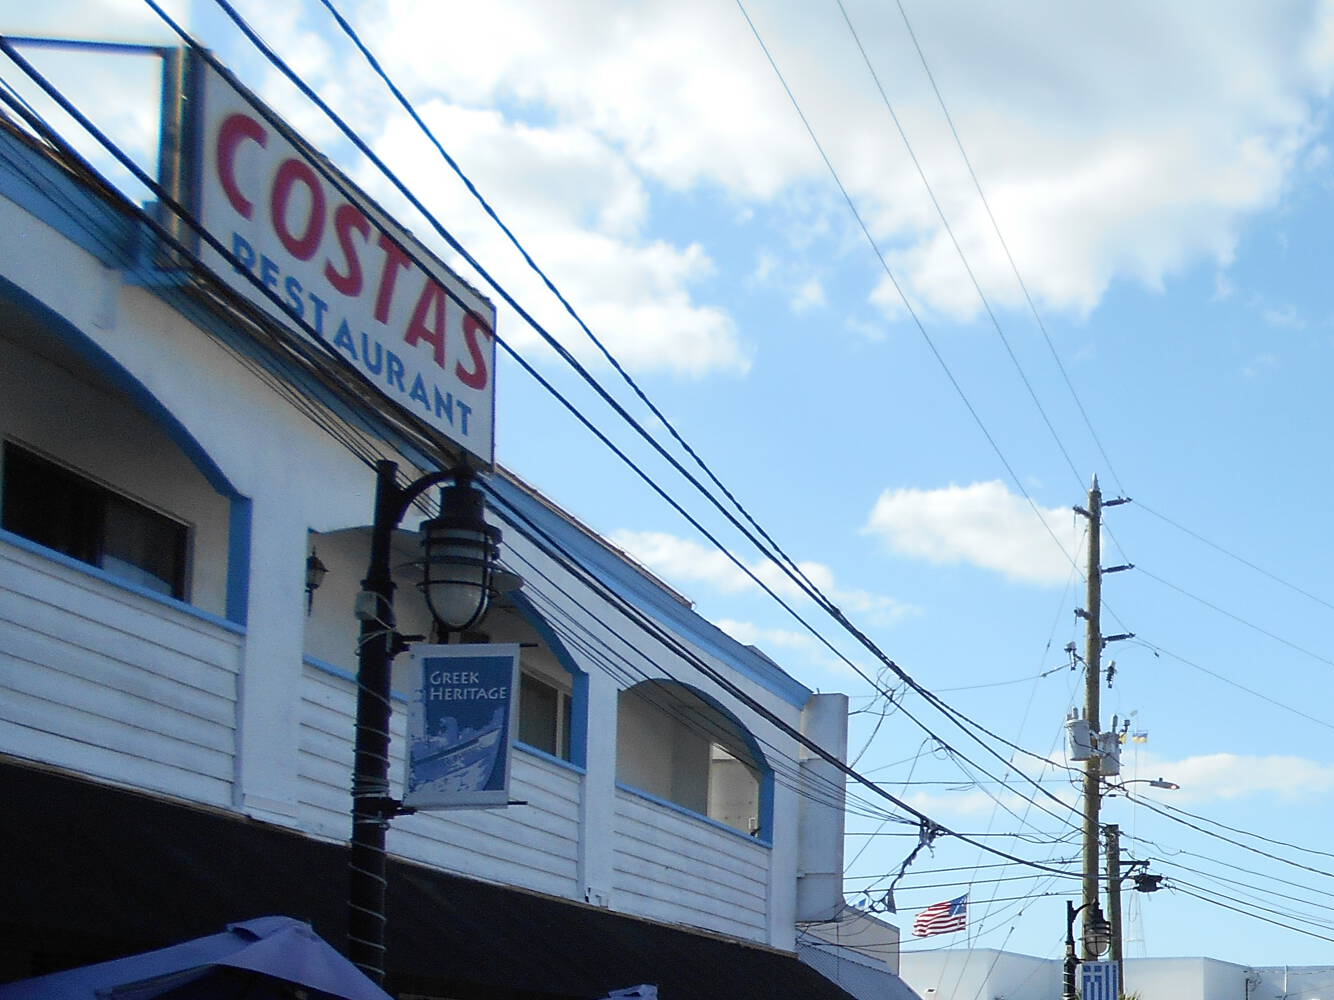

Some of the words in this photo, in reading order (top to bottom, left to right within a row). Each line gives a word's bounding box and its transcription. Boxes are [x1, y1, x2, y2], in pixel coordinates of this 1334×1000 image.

[216, 113, 493, 391] COSTAS
[231, 231, 473, 437] RESTAURANT
[430, 671, 480, 685] GREEK
[430, 687, 508, 701] HERITAGE
